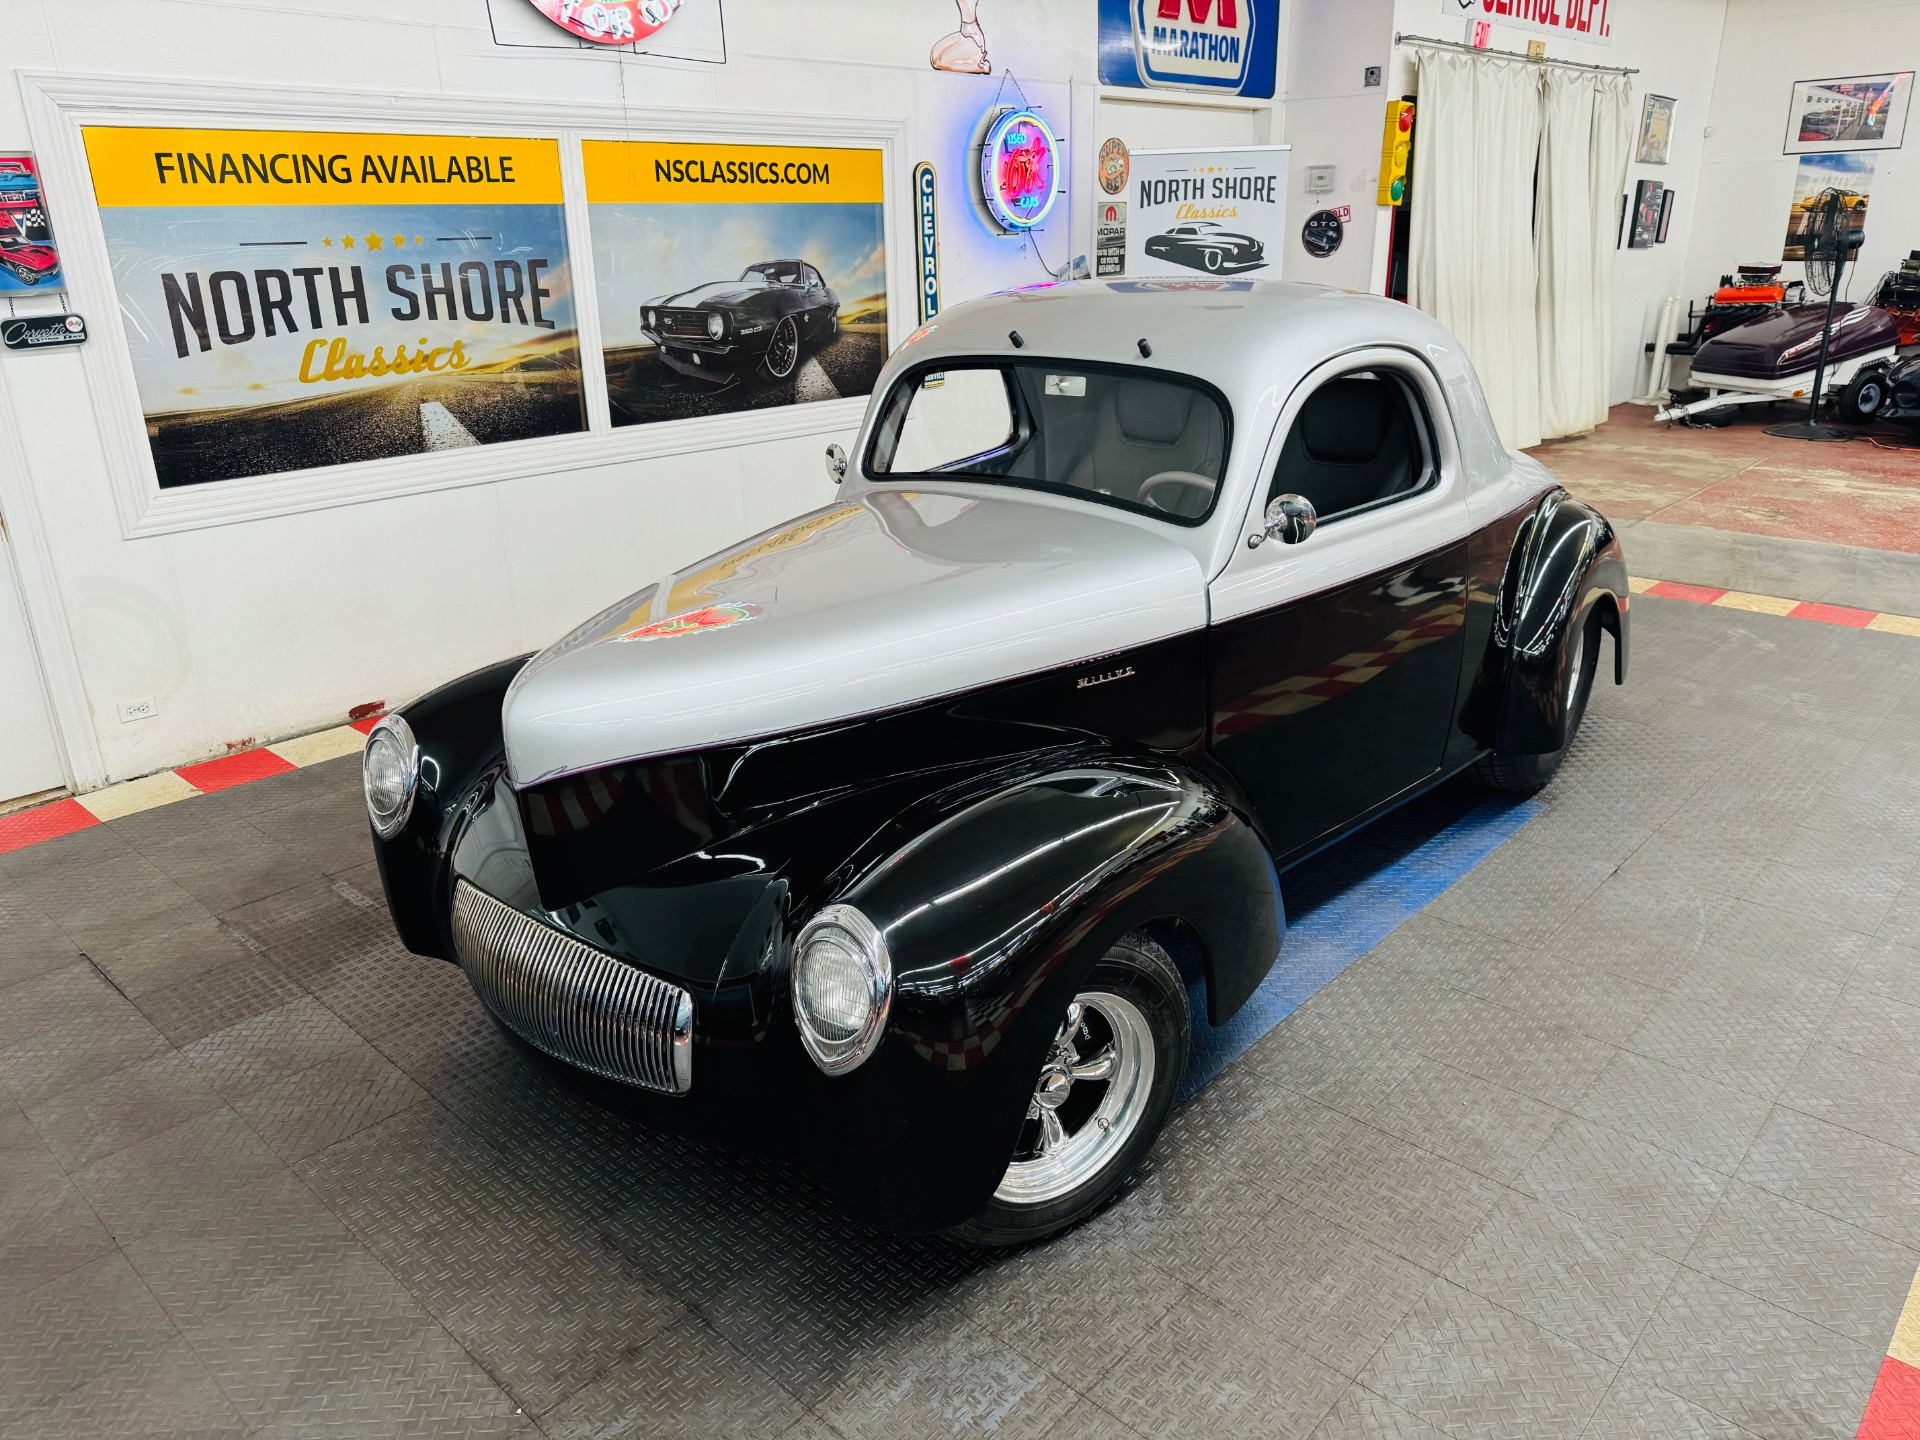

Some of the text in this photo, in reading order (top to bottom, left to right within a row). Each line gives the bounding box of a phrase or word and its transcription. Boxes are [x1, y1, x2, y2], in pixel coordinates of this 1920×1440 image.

[1151, 26, 1240, 63] MARATHON
[156, 152, 516, 184] FINANCING AVAILABLE
[1101, 141, 1126, 170] SUPER
[654, 159, 831, 185] NSCLASSICS.COM
[1105, 171, 1124, 191] BEE
[1140, 175, 1277, 209] NORTH SHORE
[1175, 203, 1239, 220] Classics
[1332, 207, 1349, 218] OLD
[1096, 227, 1125, 236] MOPAR
[922, 174, 936, 321] CHEVROL
[161, 258, 556, 359] NORTH SHORE
[5, 322, 69, 345] Corvette
[299, 337, 471, 385] Classics
